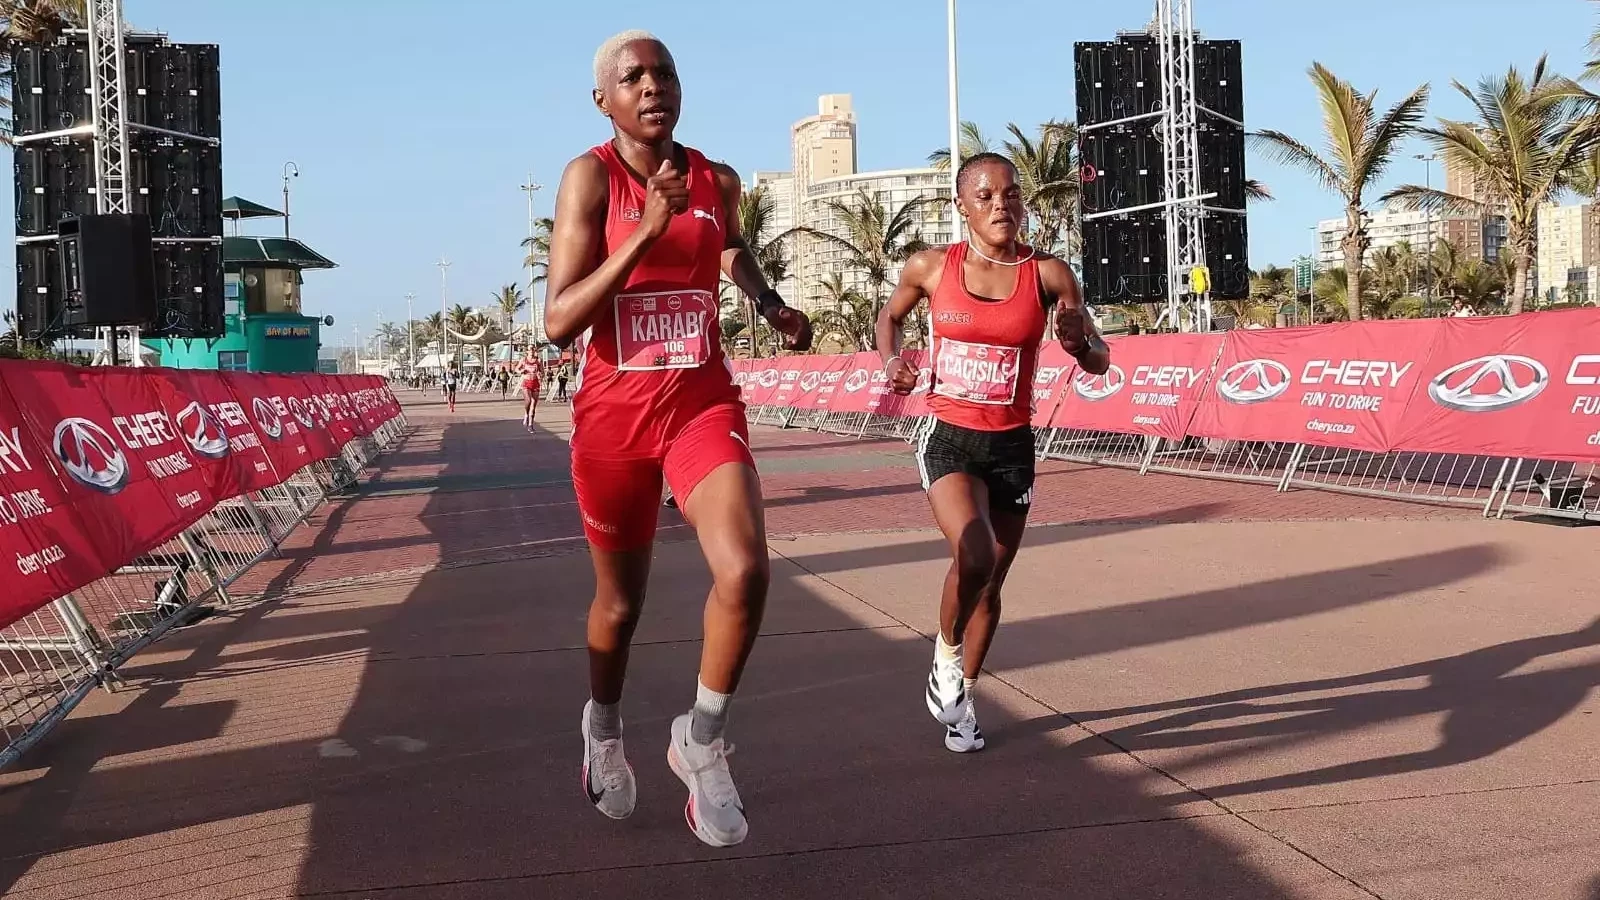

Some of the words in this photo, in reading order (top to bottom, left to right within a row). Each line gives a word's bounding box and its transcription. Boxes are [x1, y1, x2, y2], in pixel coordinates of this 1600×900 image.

[663, 341, 685, 353] 106
[668, 355, 694, 364] 2025
[1131, 365, 1205, 388] CHERY
[1300, 359, 1414, 387] CHERY
[967, 381, 981, 391] 97
[1301, 391, 1327, 407] FUN
[1328, 393, 1346, 409] TO
[1345, 394, 1383, 411] DRIVE
[112, 410, 177, 449] CHERY
[1306, 418, 1355, 434] chery.co.za
